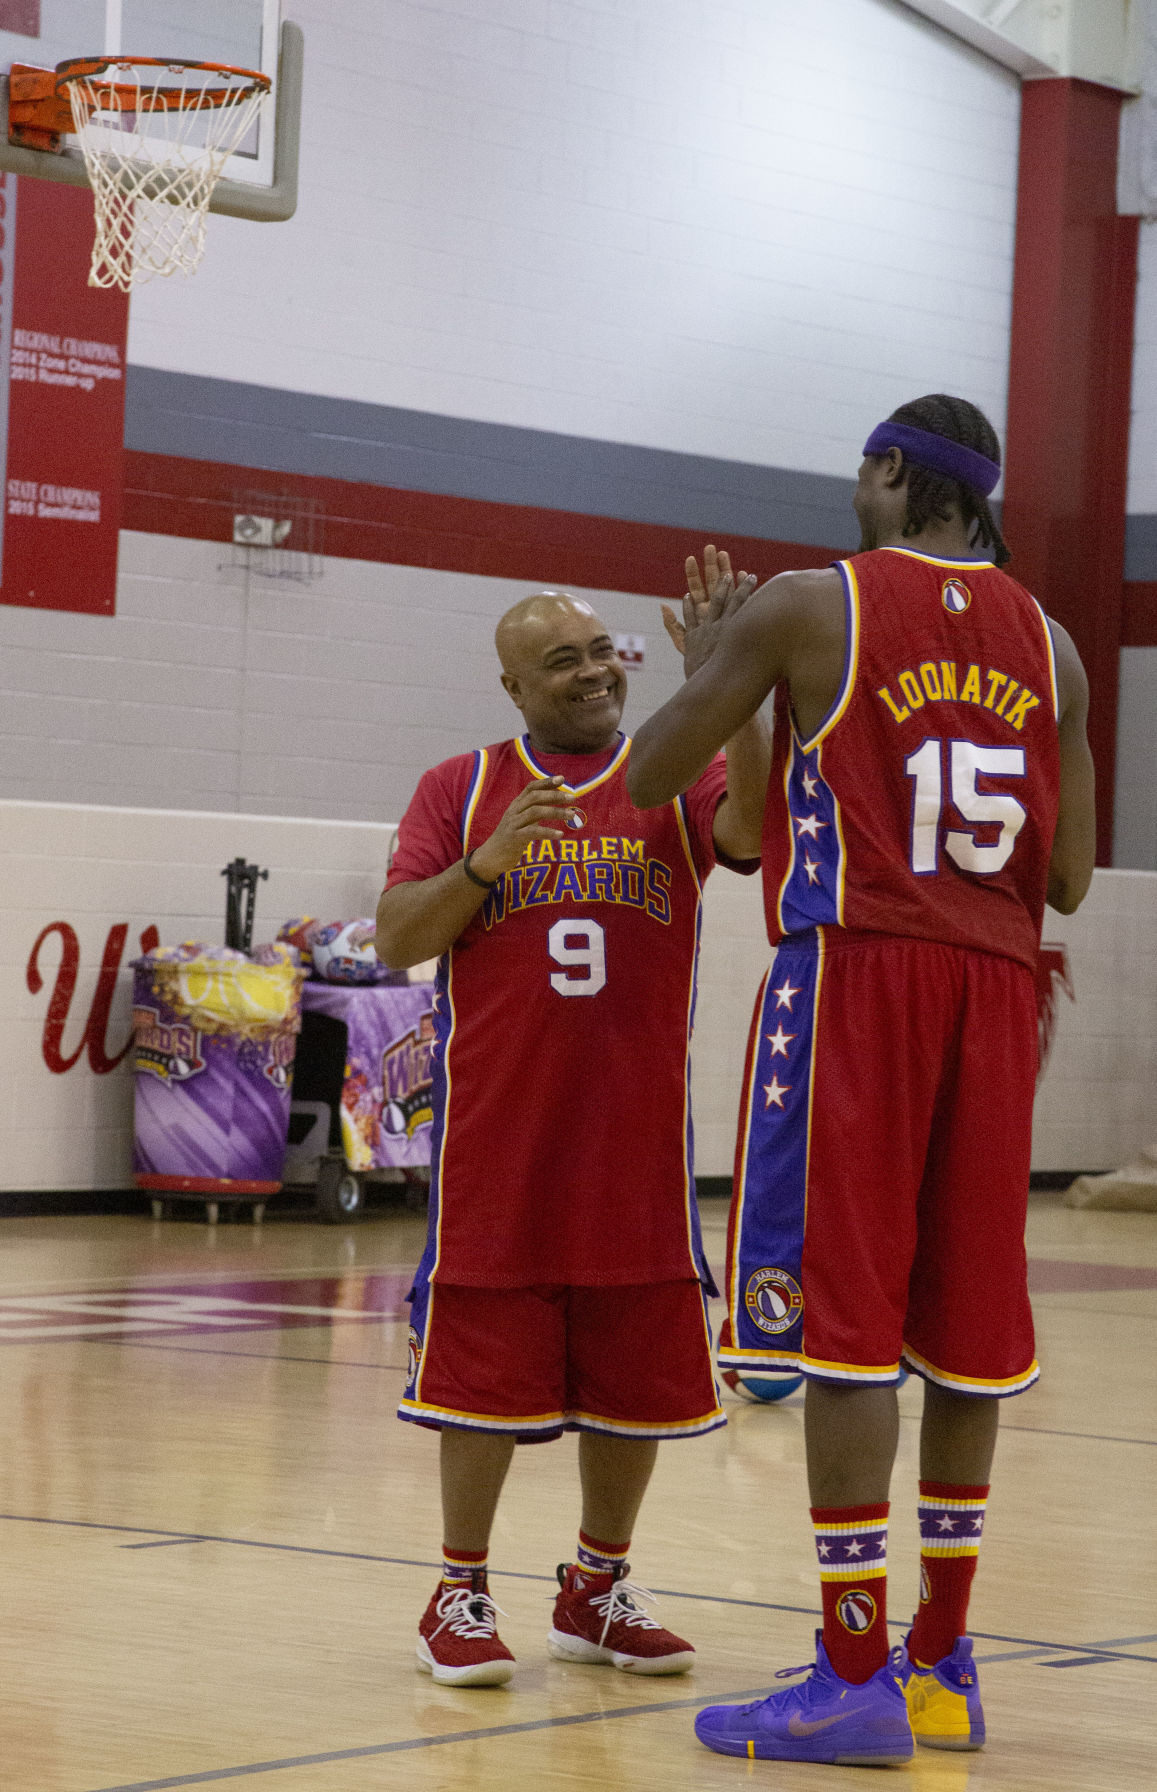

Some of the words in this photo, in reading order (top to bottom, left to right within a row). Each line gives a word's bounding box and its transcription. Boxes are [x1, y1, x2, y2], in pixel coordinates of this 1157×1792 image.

[40, 352, 66, 371] Zone
[8, 479, 38, 501] STATE
[877, 660, 1041, 732] LOONATIK
[904, 736, 1027, 876] 15
[482, 858, 672, 931] WIZARDS
[548, 918, 607, 998] 9
[755, 1270, 789, 1283] HARLEM
[758, 1316, 791, 1331] WIZARDS
